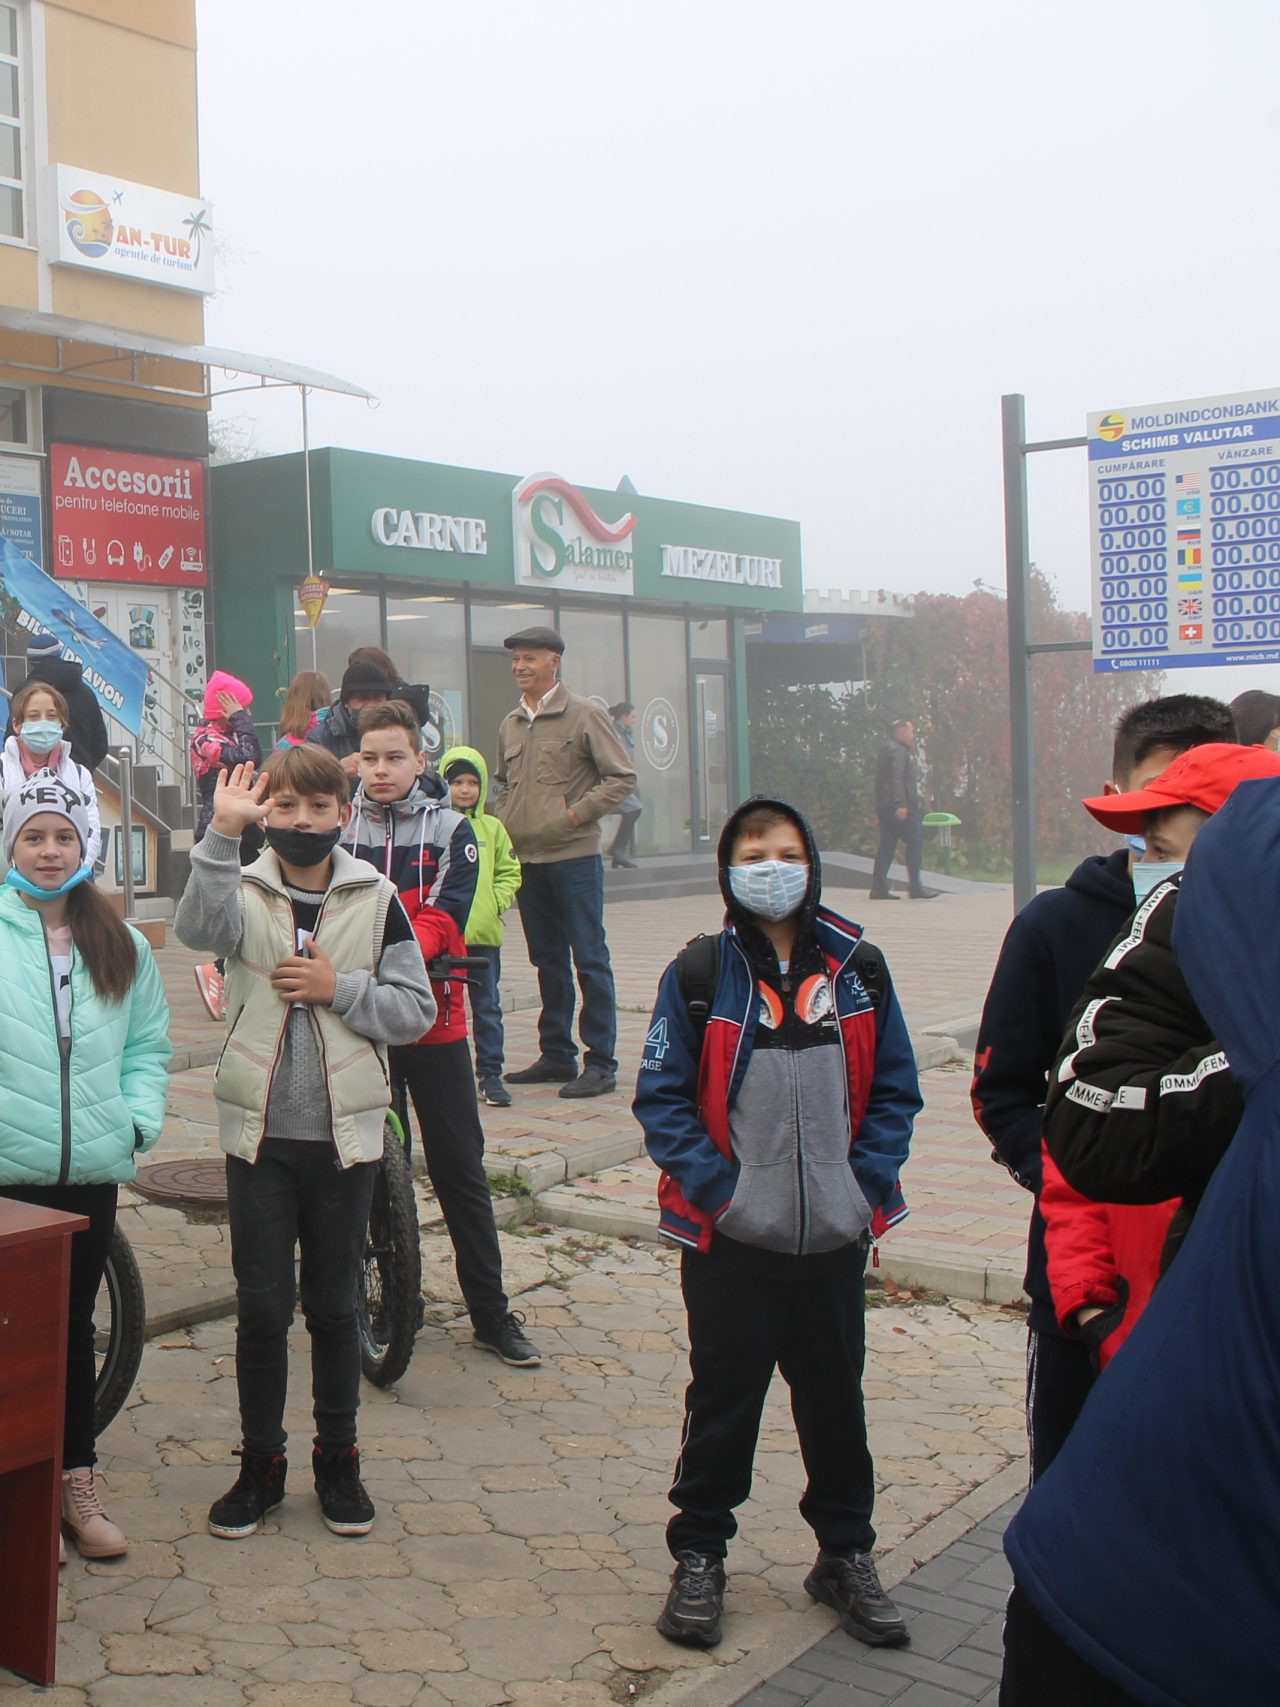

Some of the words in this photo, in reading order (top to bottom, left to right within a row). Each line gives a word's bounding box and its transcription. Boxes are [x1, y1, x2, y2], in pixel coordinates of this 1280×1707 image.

[116, 225, 191, 260] AN-TUR
[150, 253, 161, 265] de
[162, 255, 193, 272] turism
[1130, 399, 1279, 430] MOLDINDCONBANK
[1122, 434, 1179, 452] SCHIMB
[1183, 425, 1254, 444] VALUTAR
[64, 456, 192, 500] Accesorii
[1099, 478, 1166, 502] 00.00
[55, 495, 97, 510] pentru
[100, 497, 159, 517] telefoane
[162, 503, 200, 521] mobile
[1100, 503, 1166, 527] 00.00
[371, 507, 487, 555] CARNE
[528, 494, 633, 578] Salamer
[1100, 528, 1167, 551] 0.000
[660, 544, 783, 589] MEZELURI
[1101, 552, 1167, 575] 00.00
[1102, 577, 1168, 600] 00.00
[1102, 602, 1168, 624] 00.00
[1103, 627, 1168, 649] 00.00
[82, 667, 124, 710] AVION
